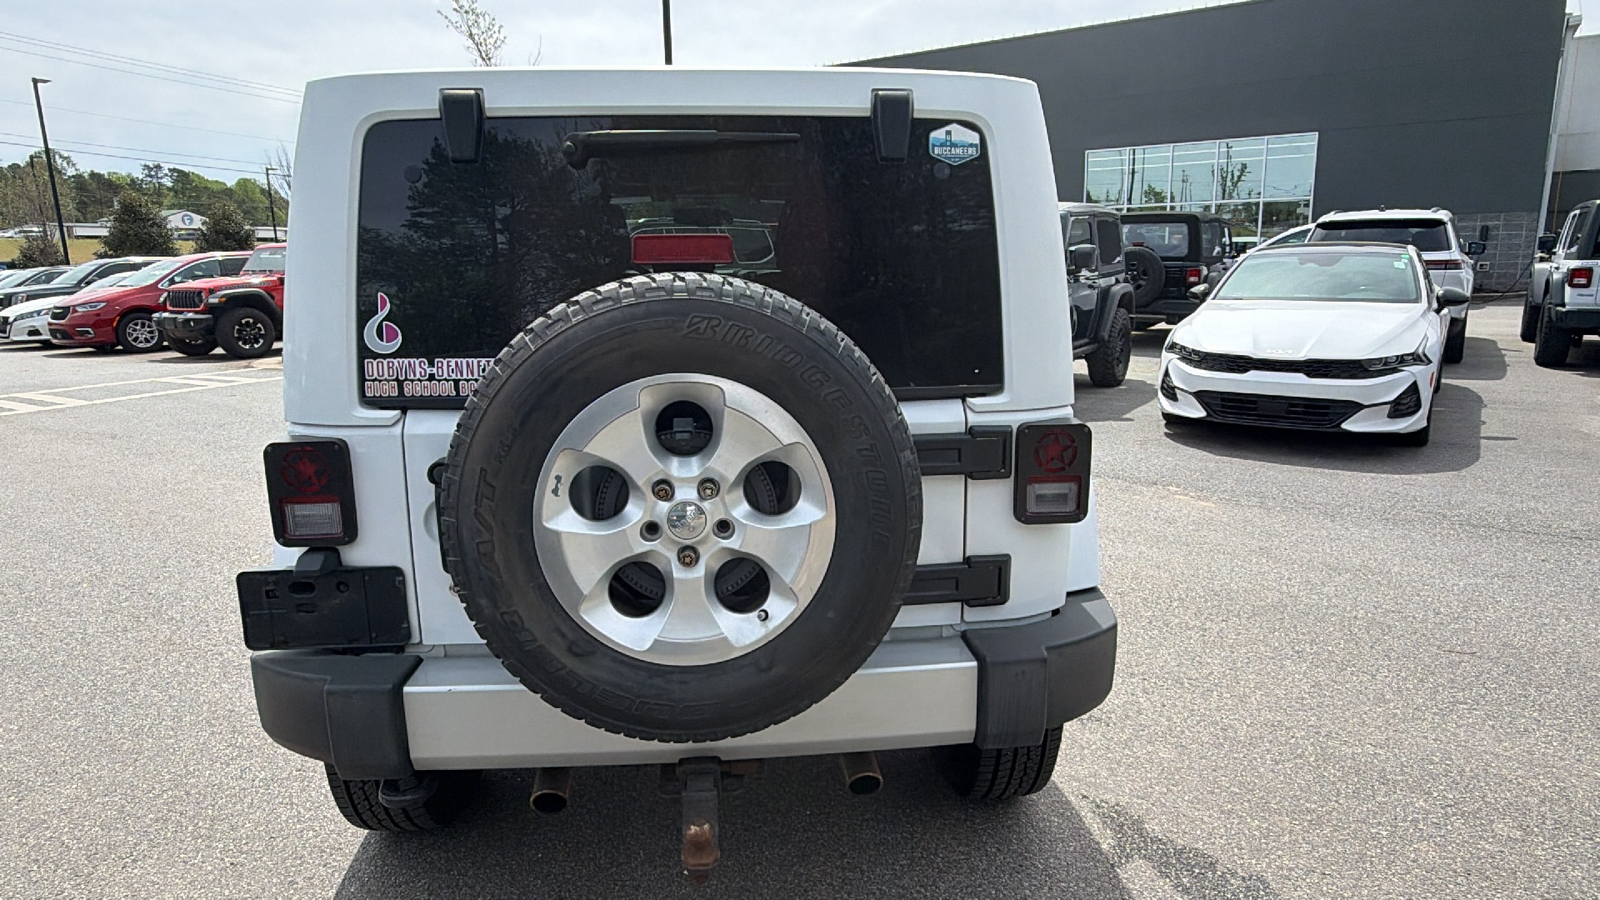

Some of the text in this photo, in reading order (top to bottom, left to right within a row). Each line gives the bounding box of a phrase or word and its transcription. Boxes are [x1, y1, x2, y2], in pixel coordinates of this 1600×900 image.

[934, 146, 977, 155] BUCCANEERS
[365, 381, 398, 397] HIGH
[404, 381, 456, 396] SCHOOL
